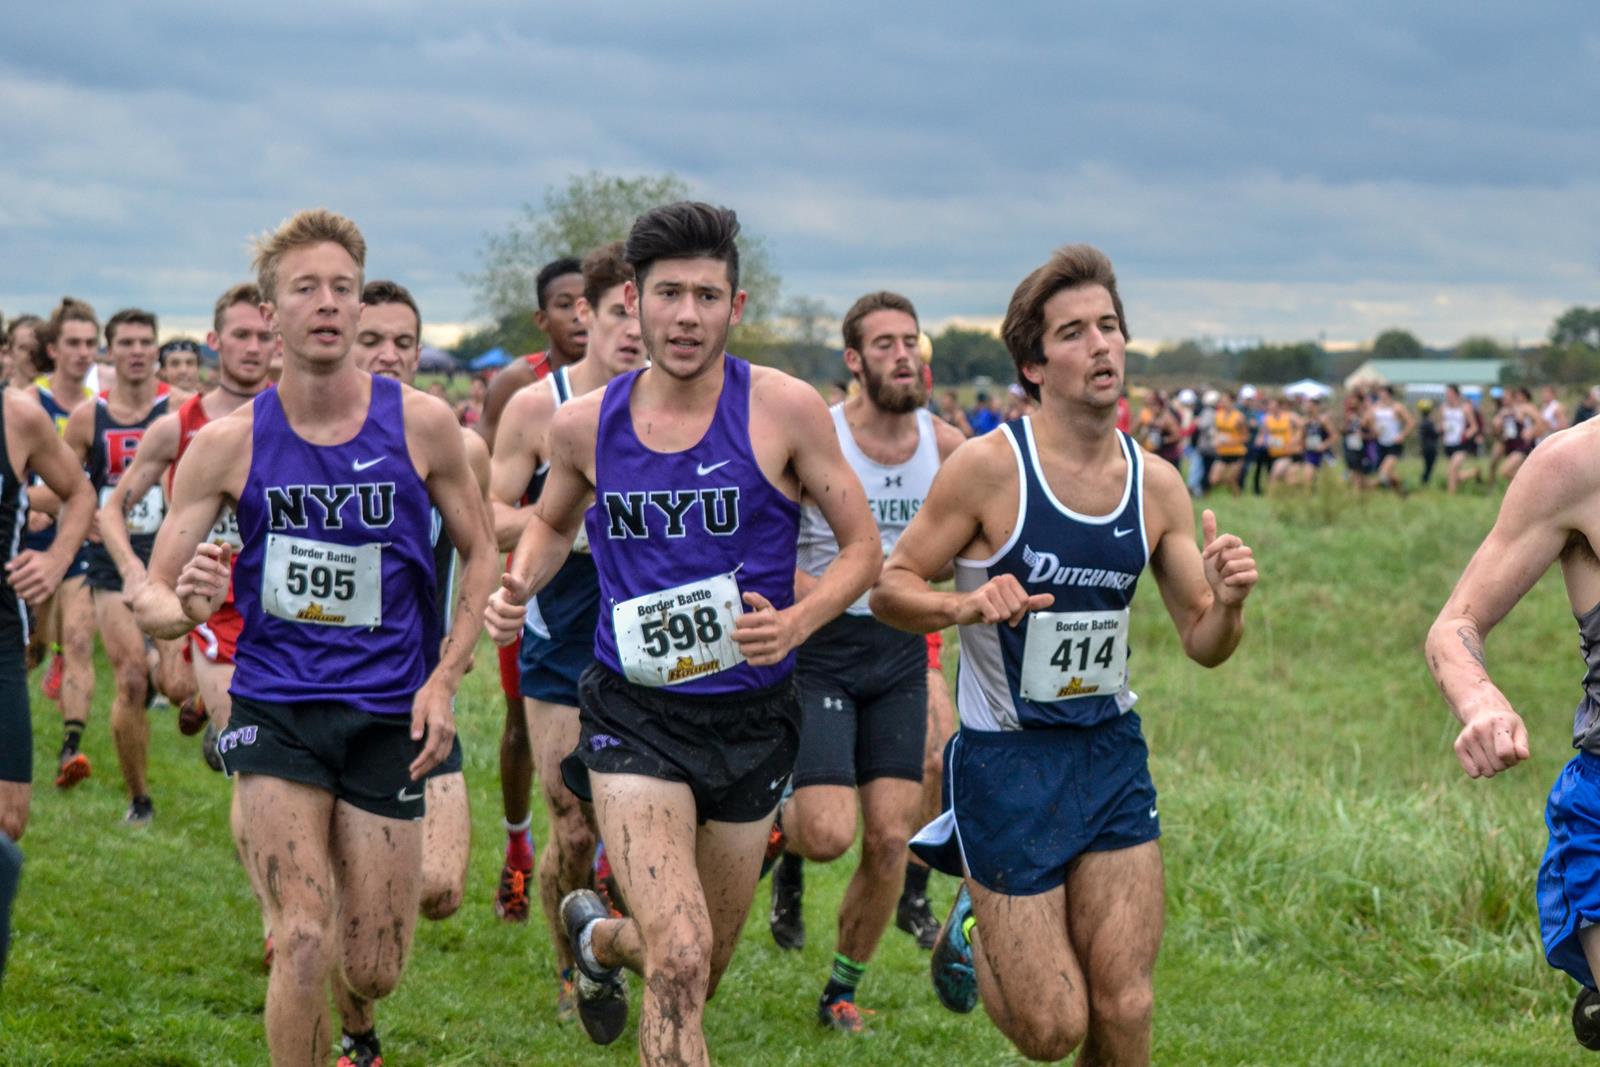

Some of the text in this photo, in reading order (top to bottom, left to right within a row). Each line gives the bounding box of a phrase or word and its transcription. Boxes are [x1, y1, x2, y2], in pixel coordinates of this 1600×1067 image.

[266, 482, 396, 529] NYU
[604, 487, 740, 539] NYU
[291, 545, 357, 564] Border Battle
[287, 562, 356, 601] 595
[637, 588, 712, 617] Border Battle
[641, 606, 723, 658] 598
[1056, 619, 1119, 632] Border Battle
[1050, 636, 1115, 672] 414
